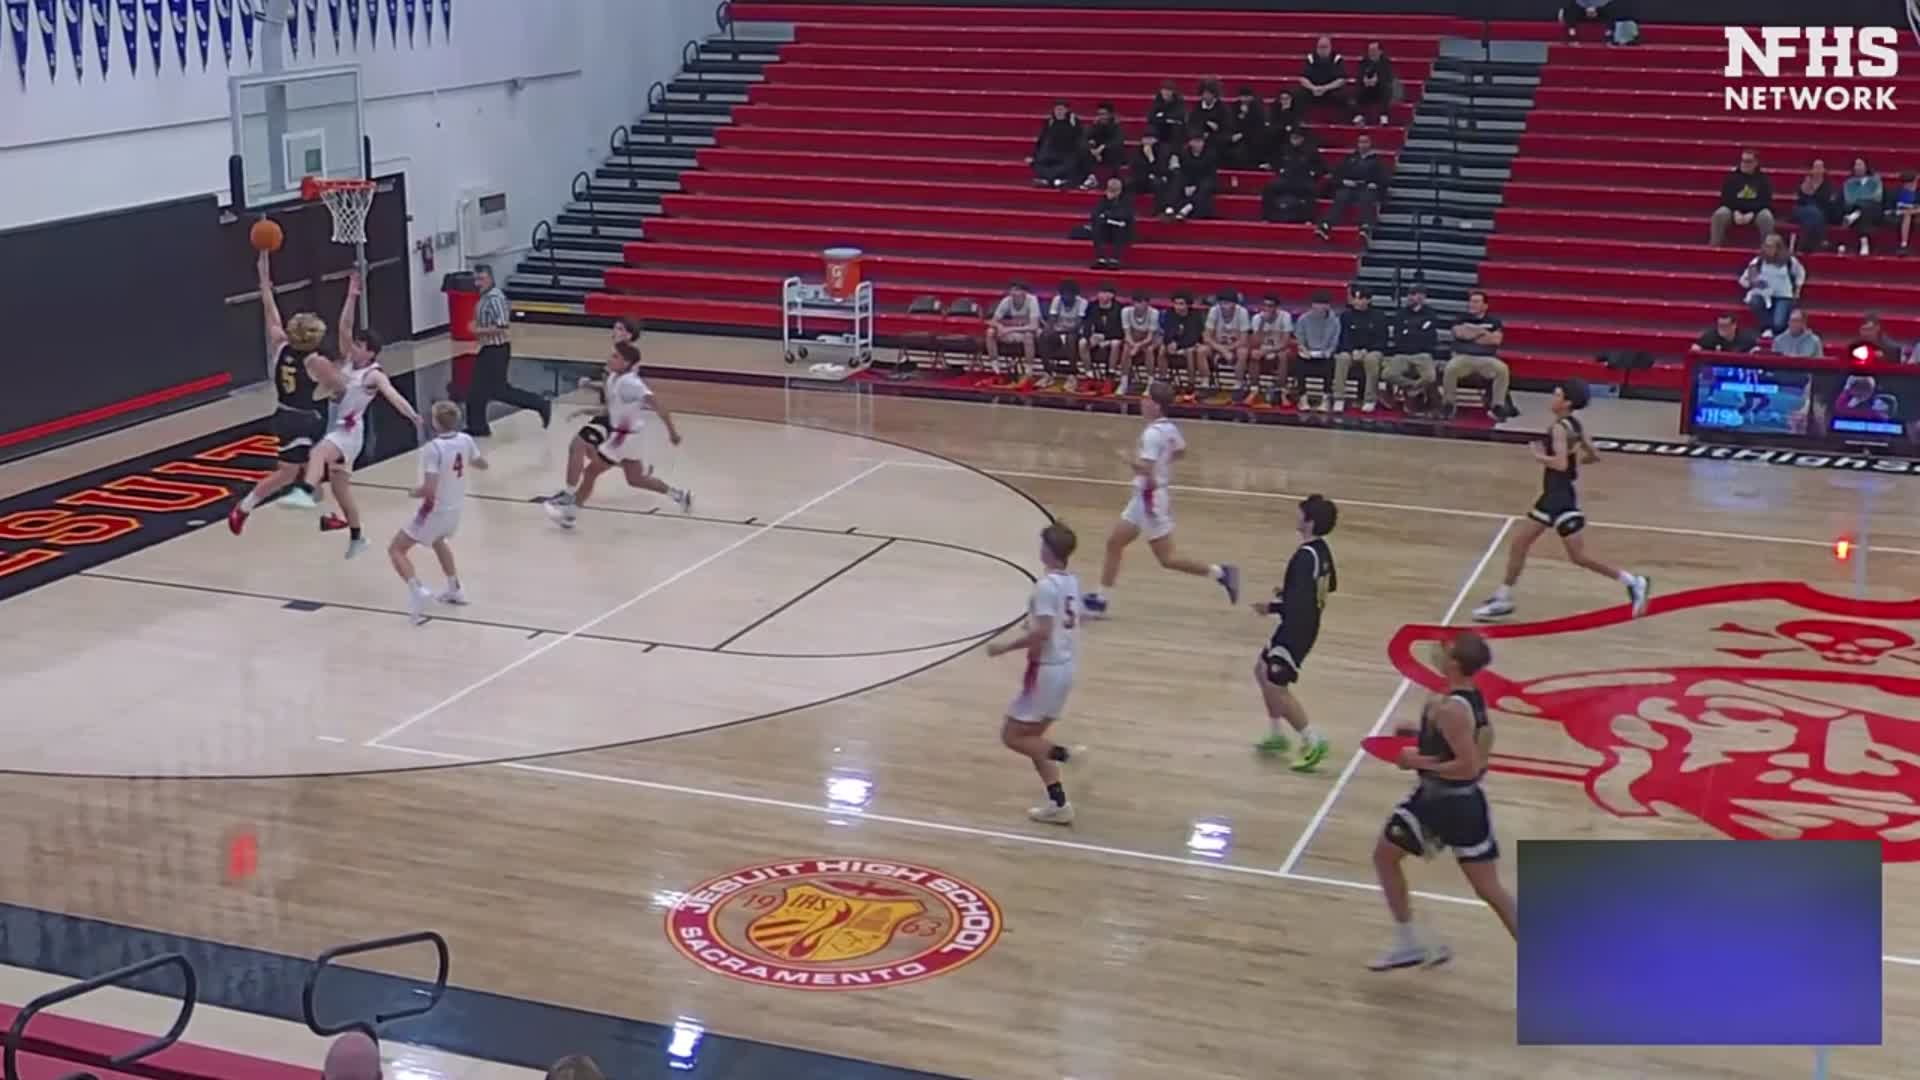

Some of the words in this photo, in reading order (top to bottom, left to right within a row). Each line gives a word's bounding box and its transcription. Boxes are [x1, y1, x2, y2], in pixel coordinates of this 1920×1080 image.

[280, 366, 297, 394] 5
[452, 453, 464, 479] 4
[1063, 595, 1076, 629] 5
[676, 862, 804, 914] JESUIT
[816, 860, 928, 882] HIGH
[926, 878, 992, 954] SCHOOL
[679, 926, 928, 985] SACRAMENTO
